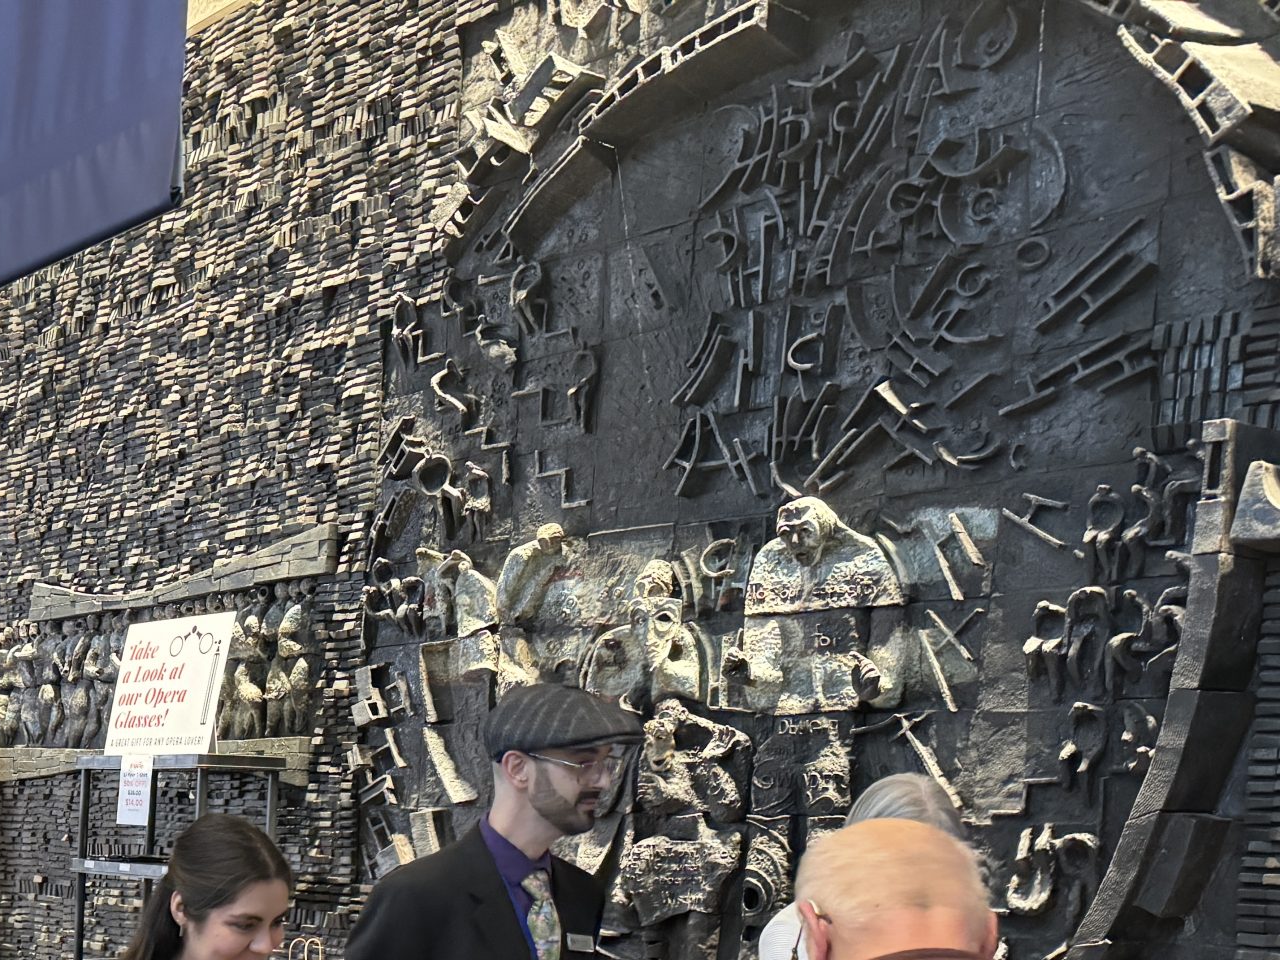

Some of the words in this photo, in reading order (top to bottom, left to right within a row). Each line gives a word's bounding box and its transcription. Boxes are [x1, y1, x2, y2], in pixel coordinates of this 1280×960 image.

[130, 640, 159, 661] Take
[122, 670, 132, 684] a
[133, 662, 167, 684] Look
[169, 662, 185, 681] at
[118, 692, 142, 707] our
[144, 687, 188, 709] Opera
[114, 708, 169, 730] Glasses!
